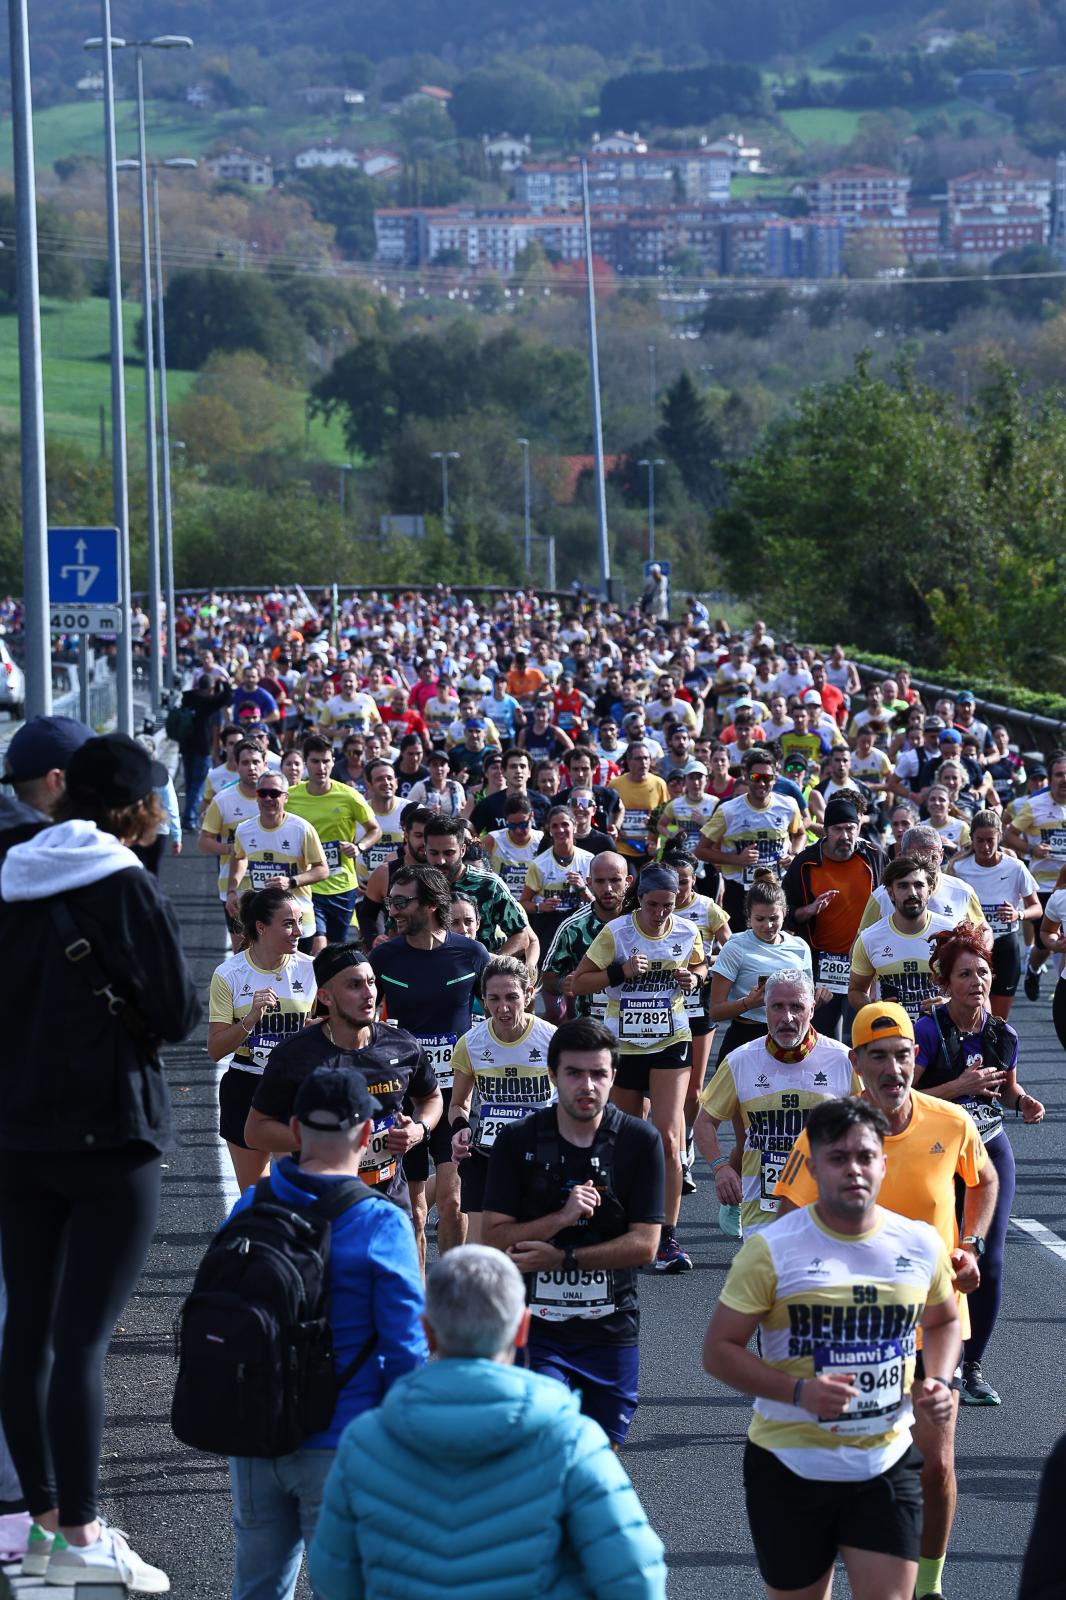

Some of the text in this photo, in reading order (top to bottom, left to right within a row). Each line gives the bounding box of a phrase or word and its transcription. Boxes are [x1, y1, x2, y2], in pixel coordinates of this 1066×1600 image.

[50, 614, 114, 629] 400 m
[651, 962, 662, 970] 59
[903, 961, 918, 973] 59
[627, 999, 656, 1008] luanvi
[624, 1011, 669, 1025] 27892
[504, 1067, 518, 1077] 59
[781, 1093, 800, 1109] 59
[489, 1106, 523, 1117] luanvi
[562, 1291, 583, 1300] UNAI
[852, 1285, 878, 1305] 59
[829, 1347, 882, 1364] luanvi
